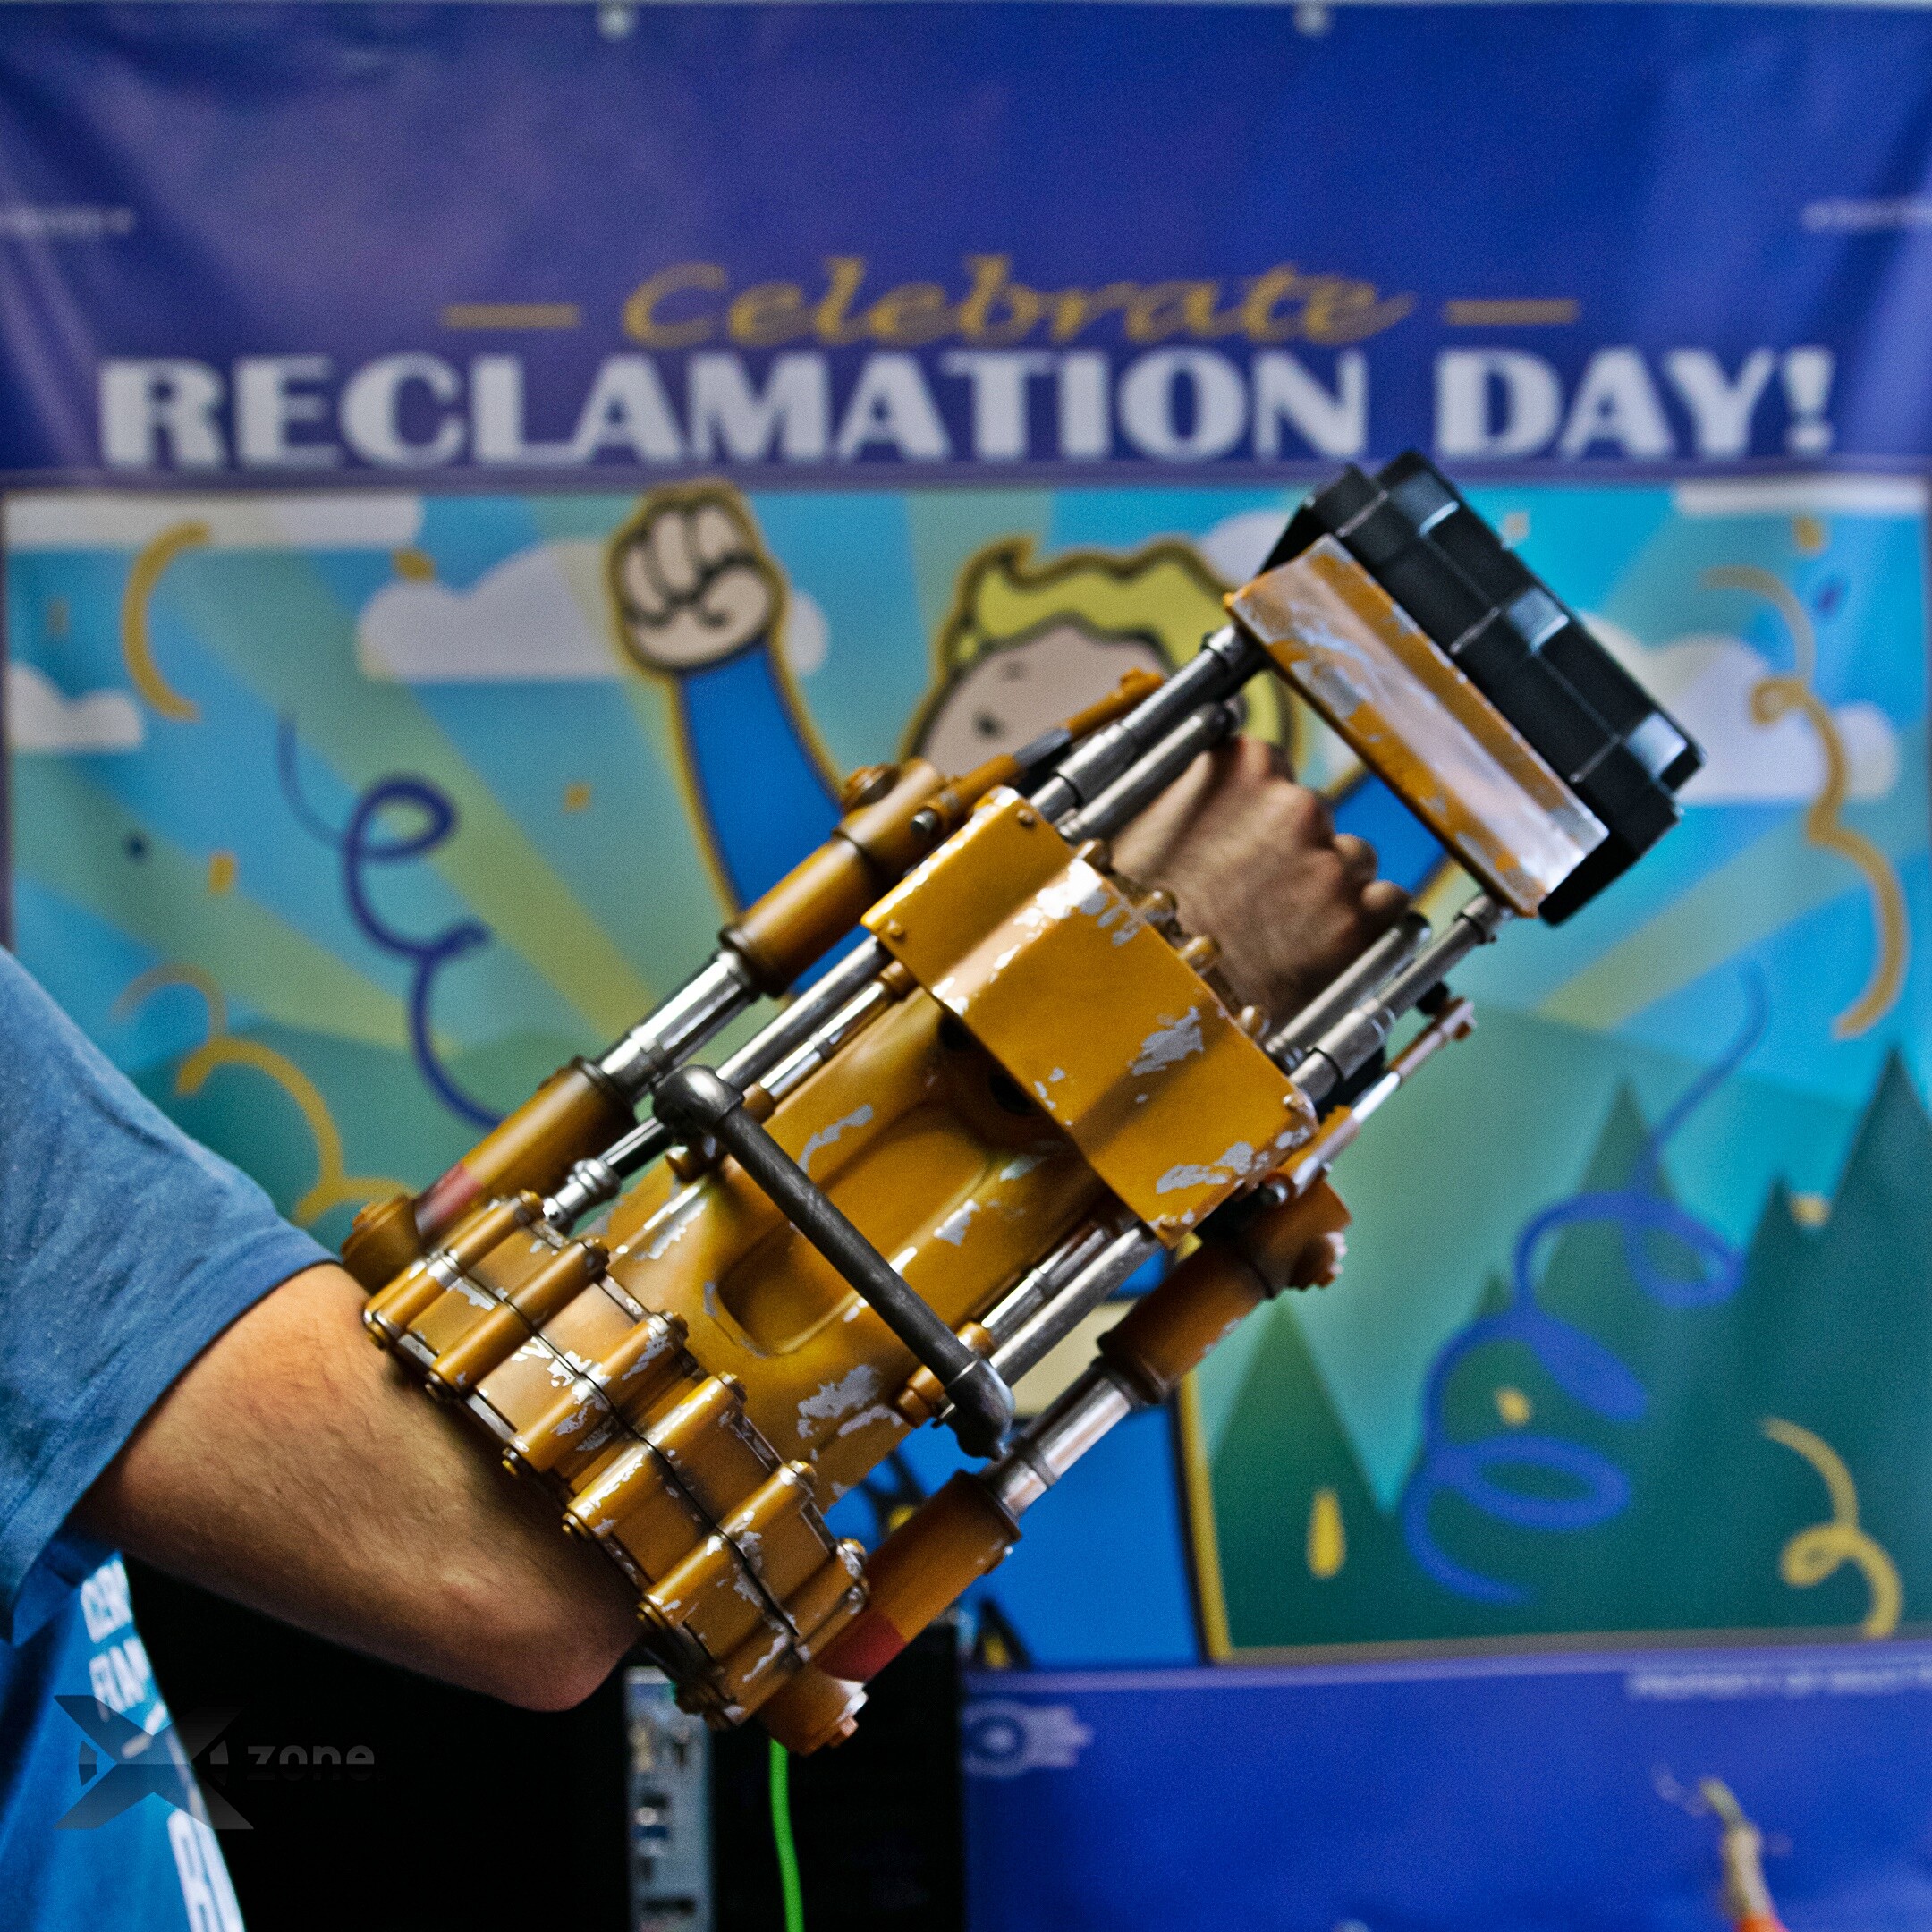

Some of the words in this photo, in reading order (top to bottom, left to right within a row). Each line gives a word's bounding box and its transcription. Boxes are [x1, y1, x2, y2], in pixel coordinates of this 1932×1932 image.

[622, 254, 1415, 347] Celebrate
[98, 350, 1368, 470] RECLAMATION
[1436, 347, 1835, 462] DAY!
